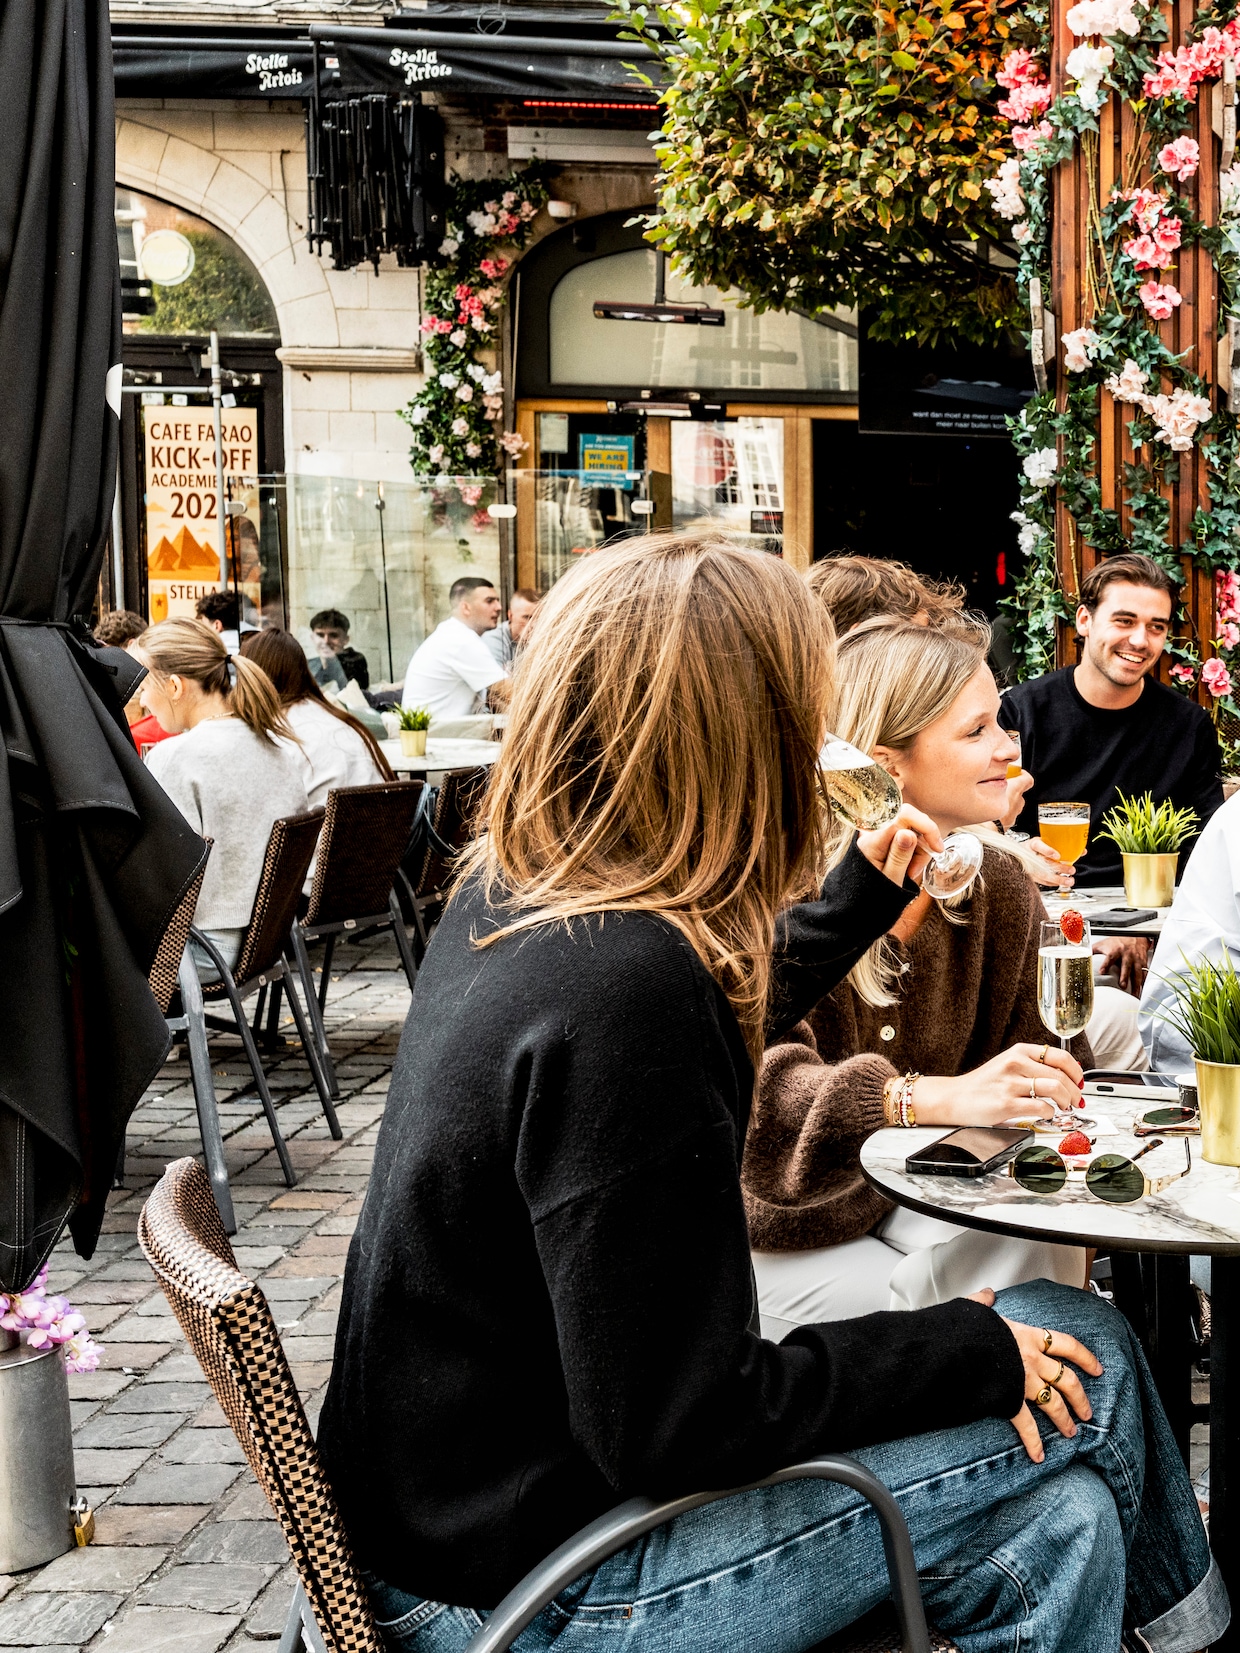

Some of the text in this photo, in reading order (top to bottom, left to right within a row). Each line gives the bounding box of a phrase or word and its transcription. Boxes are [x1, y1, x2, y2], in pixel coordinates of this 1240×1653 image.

[245, 53, 288, 74] Stella
[389, 48, 438, 67] Stella
[259, 68, 303, 91] Artois
[403, 62, 452, 85] Artois
[150, 422, 252, 442] CAFE FARAO
[151, 446, 252, 471] KICK-OFF
[606, 453, 625, 461] ARE
